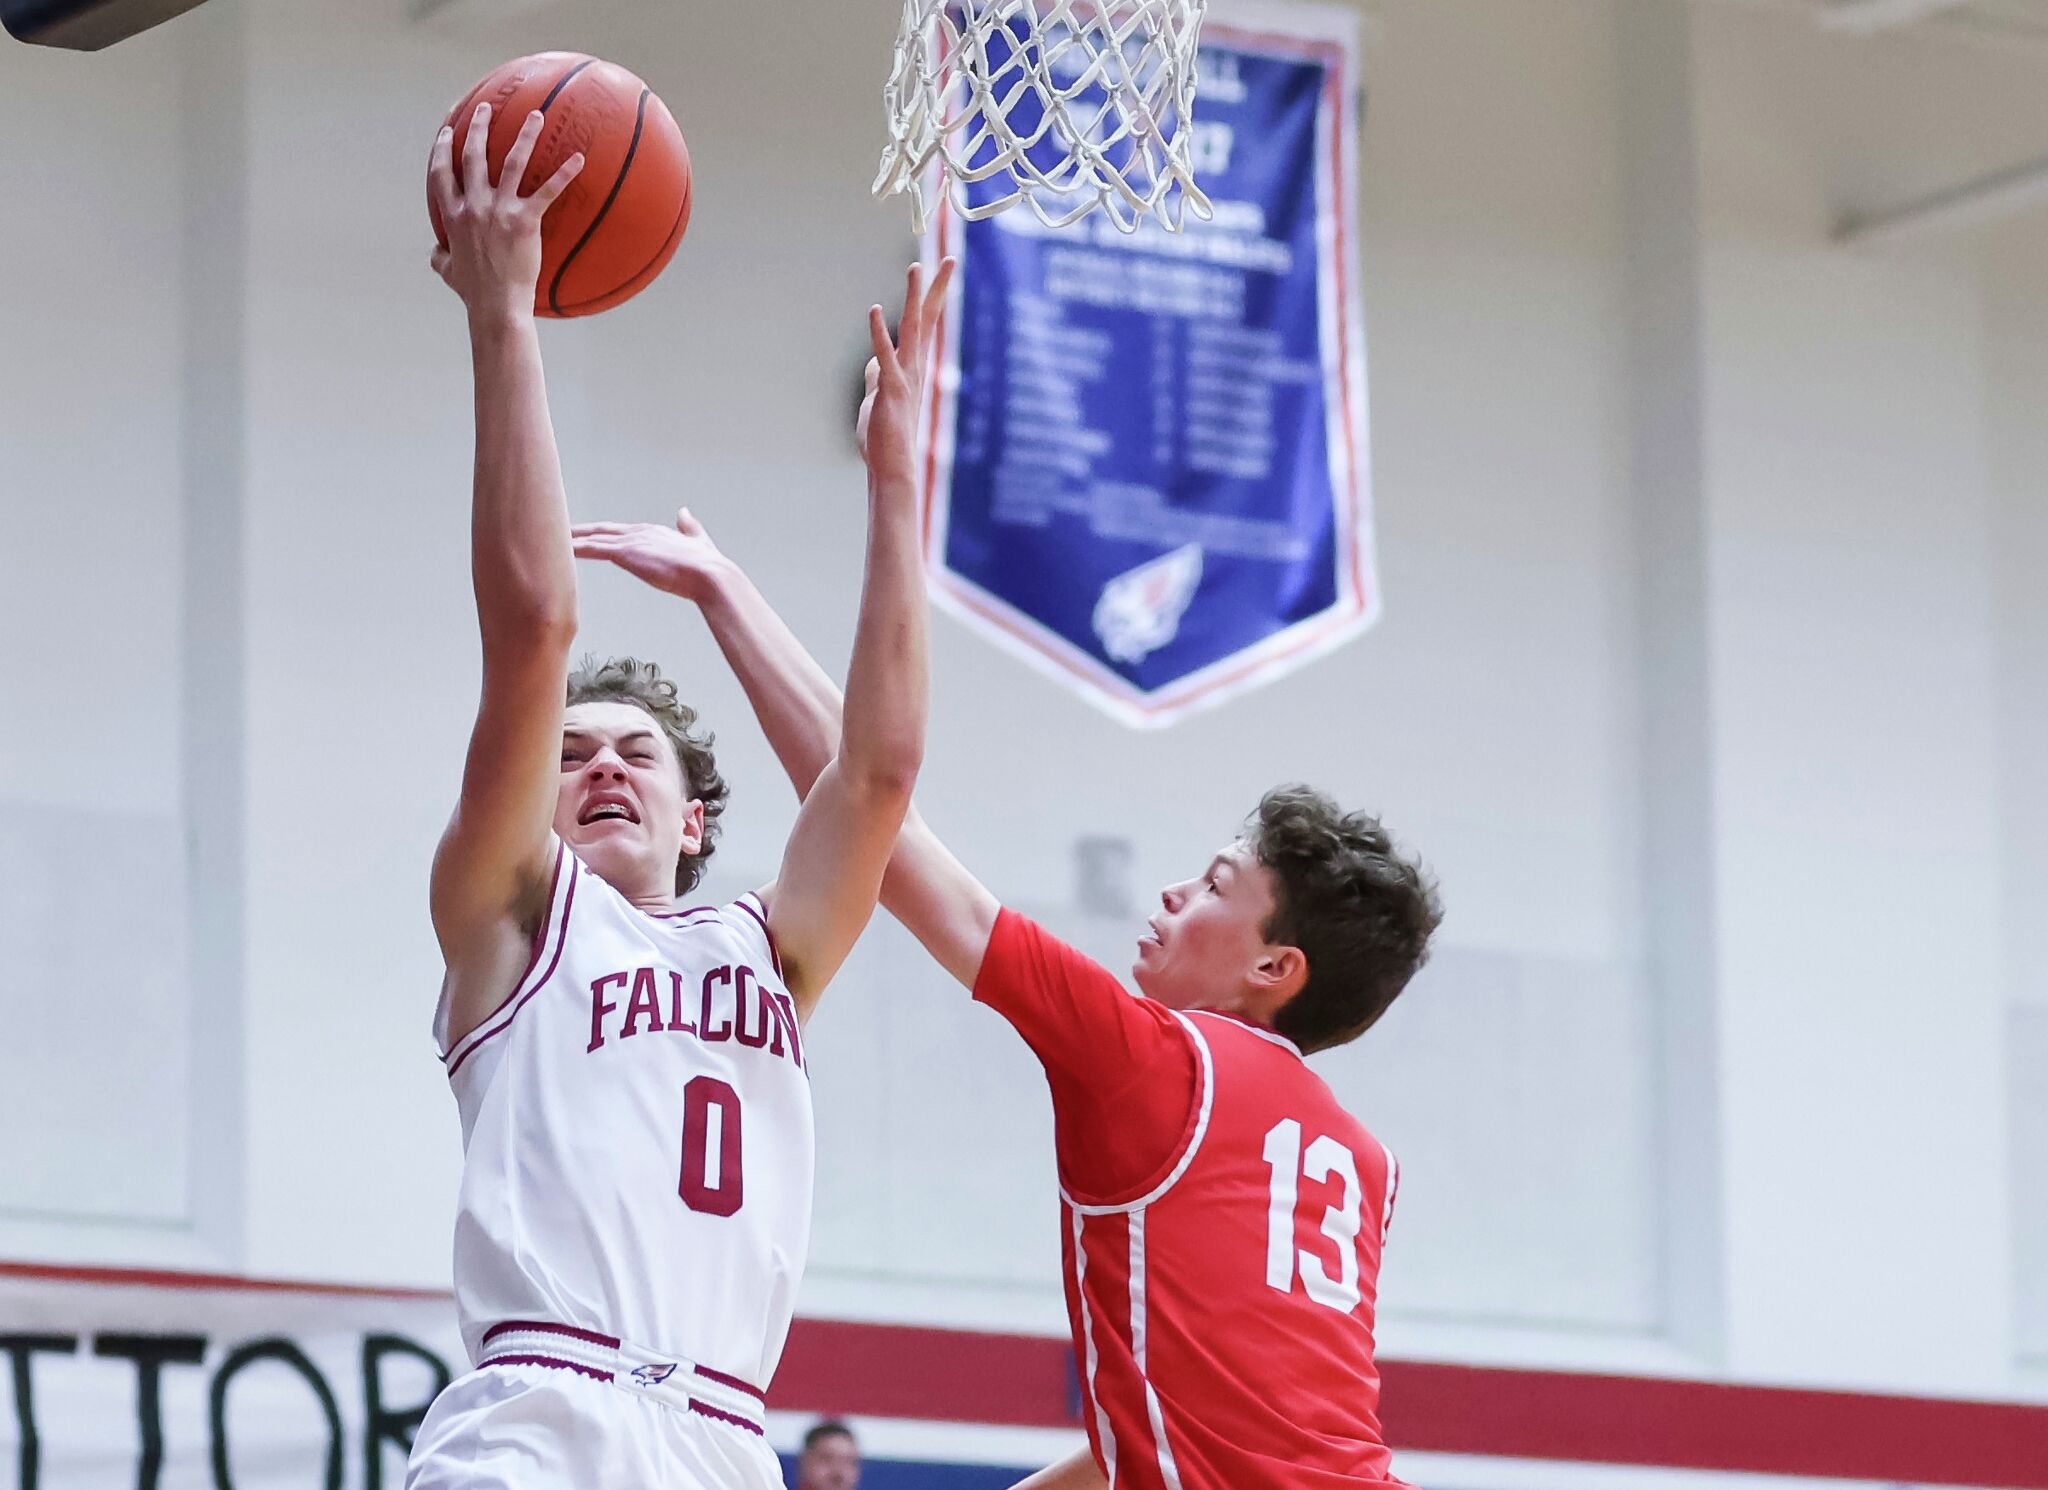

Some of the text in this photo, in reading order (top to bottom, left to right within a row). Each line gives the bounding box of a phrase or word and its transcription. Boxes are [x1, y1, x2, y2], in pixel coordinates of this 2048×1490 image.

[586, 964, 810, 1080] FALCON
[678, 1074, 744, 1218] 0
[1261, 1116, 1362, 1316] 13
